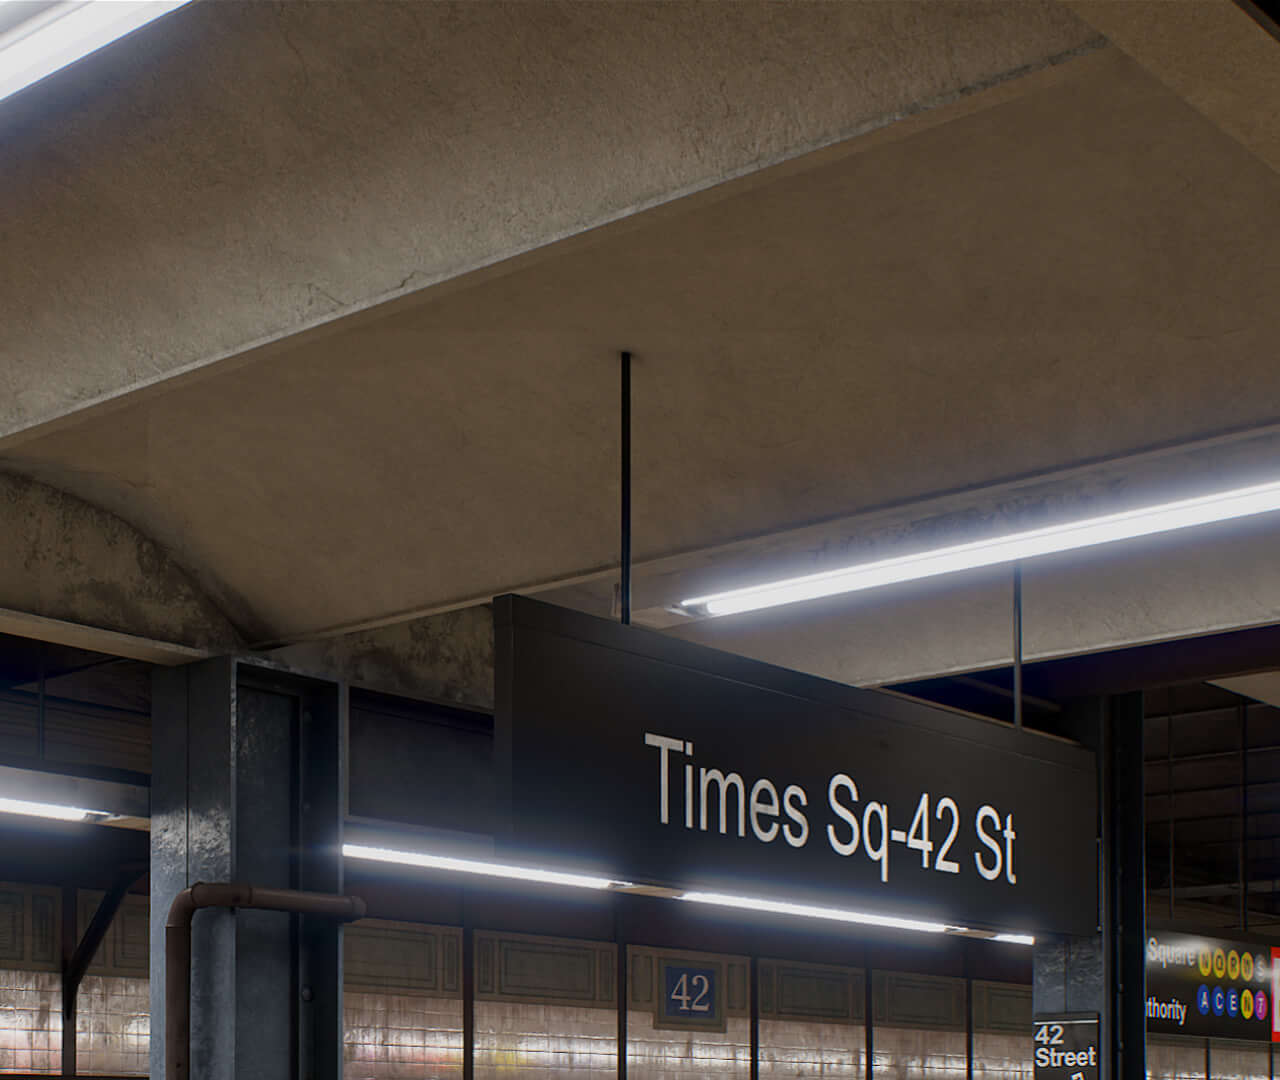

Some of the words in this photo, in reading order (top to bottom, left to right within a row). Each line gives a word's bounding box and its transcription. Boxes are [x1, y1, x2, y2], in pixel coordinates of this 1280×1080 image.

[644, 732, 809, 848] Times
[827, 773, 960, 883] Sq-42
[974, 804, 1017, 885] St
[1147, 937, 1196, 969] Square
[671, 973, 710, 1011] 42
[1145, 996, 1187, 1026] thority
[1034, 1024, 1065, 1045] 42
[1035, 1046, 1097, 1068] Street
